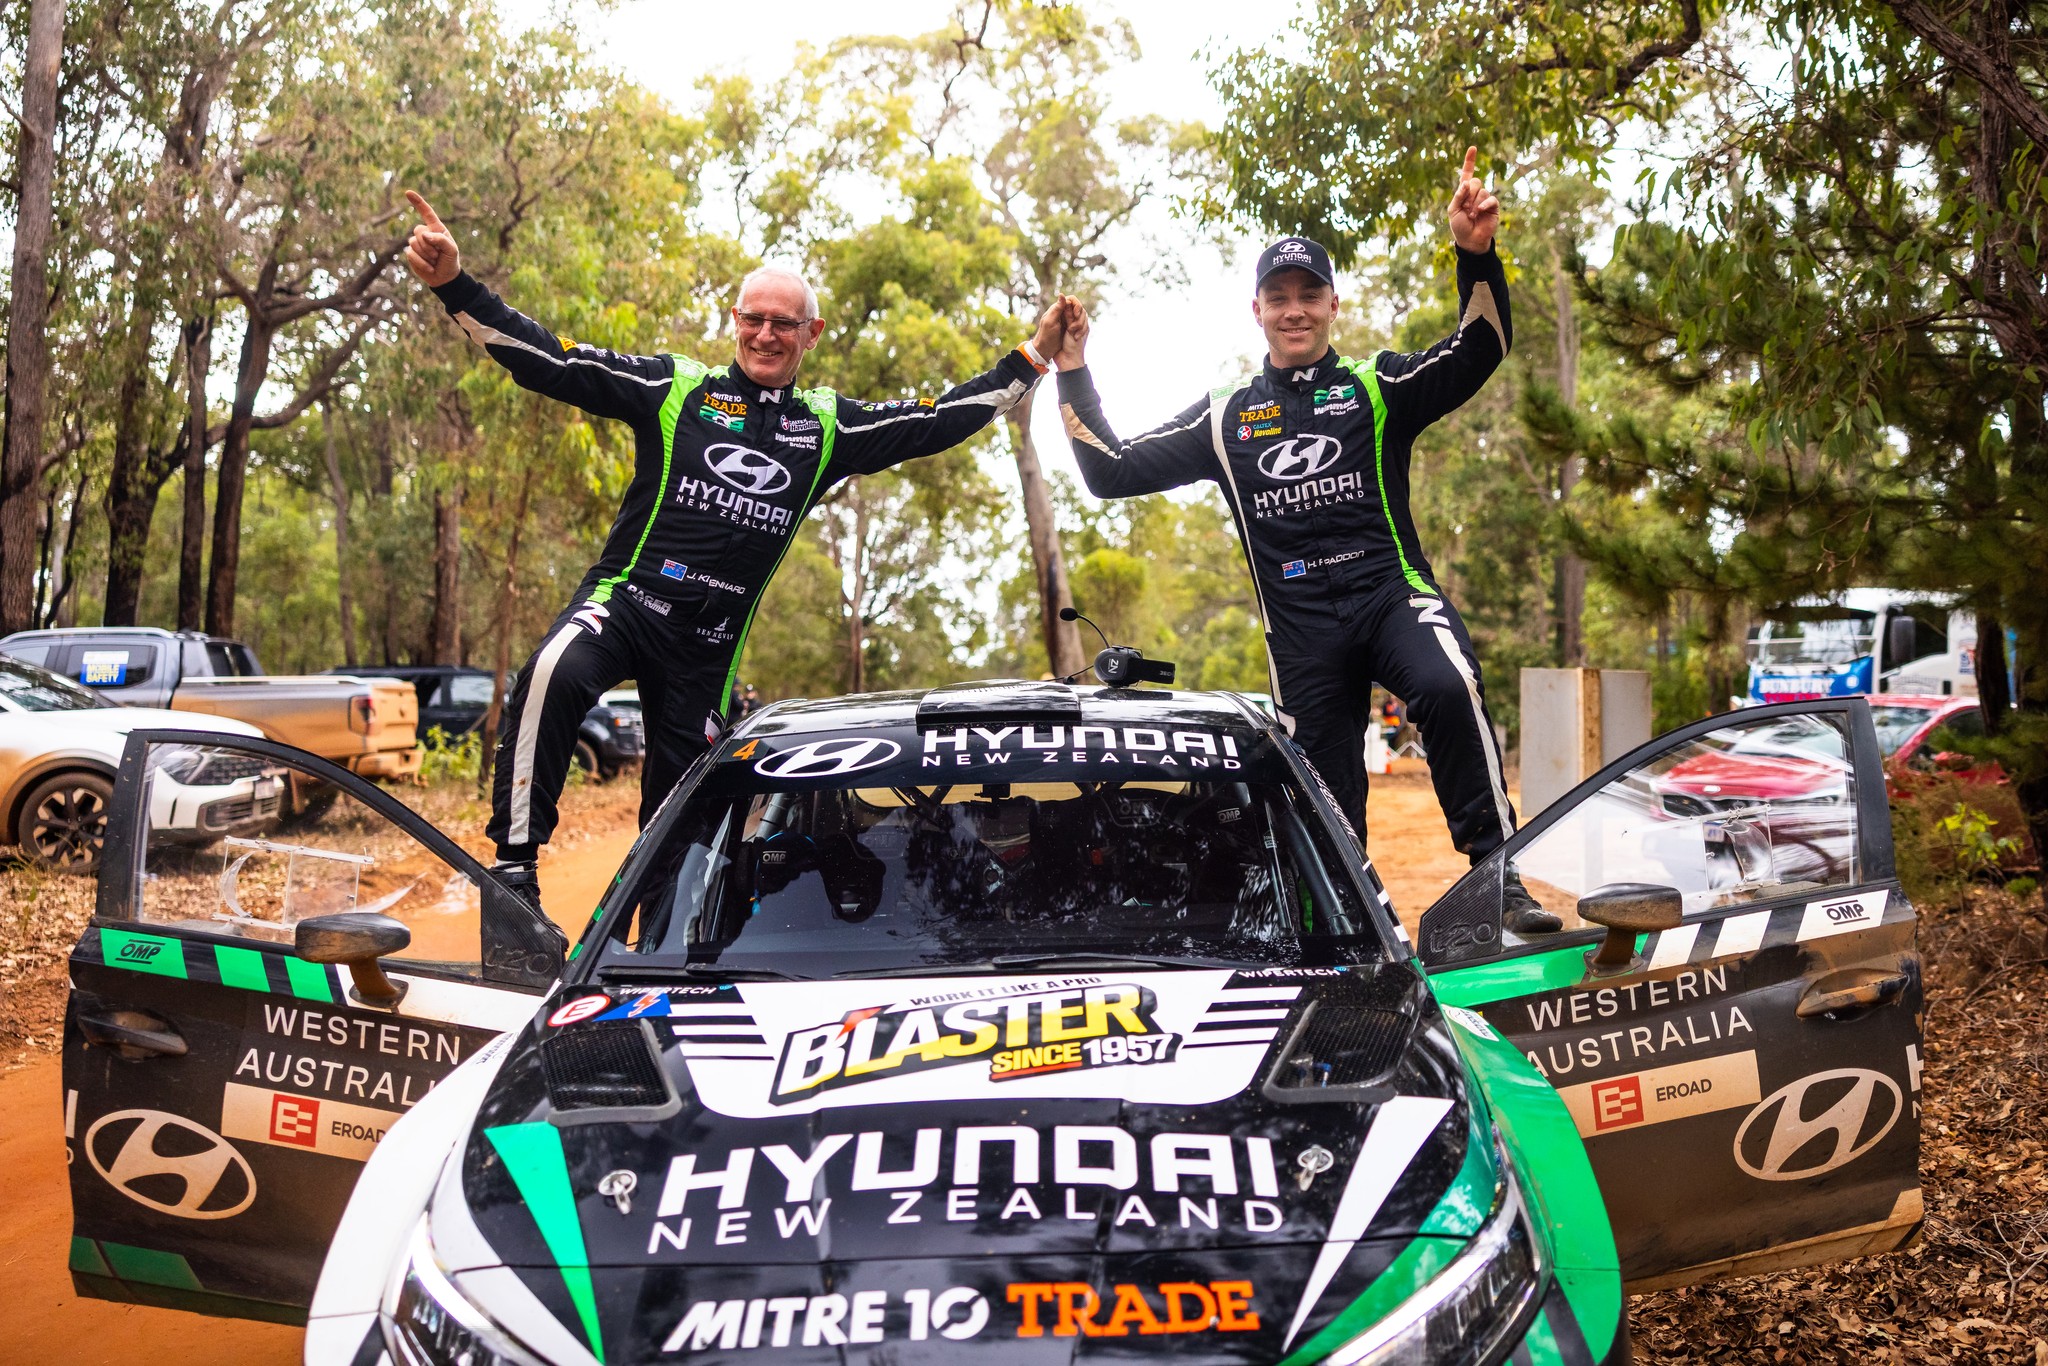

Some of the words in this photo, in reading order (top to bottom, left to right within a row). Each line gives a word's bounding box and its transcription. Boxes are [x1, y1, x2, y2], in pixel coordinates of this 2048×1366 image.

[1273, 253, 1312, 263] HYUNDAI
[703, 392, 747, 415] TRADE
[711, 392, 733, 402] MITRE
[734, 395, 742, 403] 10
[1239, 405, 1281, 422] TRADE
[678, 475, 793, 526] HYUNDAI
[1253, 471, 1363, 511] HYUNDAI
[676, 494, 710, 512] NEW
[719, 508, 787, 536] ZEALAND
[1256, 507, 1285, 519] NEW
[1294, 490, 1365, 513] ZEALAND
[86, 673, 119, 683] SAFETY
[87, 664, 120, 675] MOBILE
[732, 738, 760, 760] 4
[923, 725, 1239, 758] HYUNDAI
[921, 751, 1012, 768] NEW
[1043, 751, 1242, 770] ZEALAND
[1218, 809, 1241, 822] OMP
[762, 852, 787, 863] OMP
[1826, 903, 1866, 922] OMP
[121, 942, 162, 960] OMP
[1238, 968, 1341, 978] WIPERTECH
[620, 986, 717, 995] WIPERTECH
[910, 990, 972, 1006] WORK
[978, 987, 995, 997] IT
[1001, 982, 1044, 994] LIKE
[1047, 980, 1060, 989] A
[1062, 976, 1102, 987] PRO
[1526, 964, 1728, 1032] WESTERN
[264, 1004, 461, 1066] WESTERN
[776, 983, 1148, 1096] BLASTER
[1526, 1006, 1754, 1078] AUSTRALIA
[991, 1041, 1083, 1074] SINCE
[1082, 1033, 1174, 1066] 1957
[1655, 1078, 1713, 1102] EROAD
[656, 1125, 1281, 1218] HYUNDAI
[647, 1197, 832, 1255] NEW
[887, 1186, 1284, 1234] ZEALAND
[661, 1289, 888, 1353] MITRE
[903, 1286, 990, 1342] 10
[1006, 1280, 1261, 1339] TRADE
